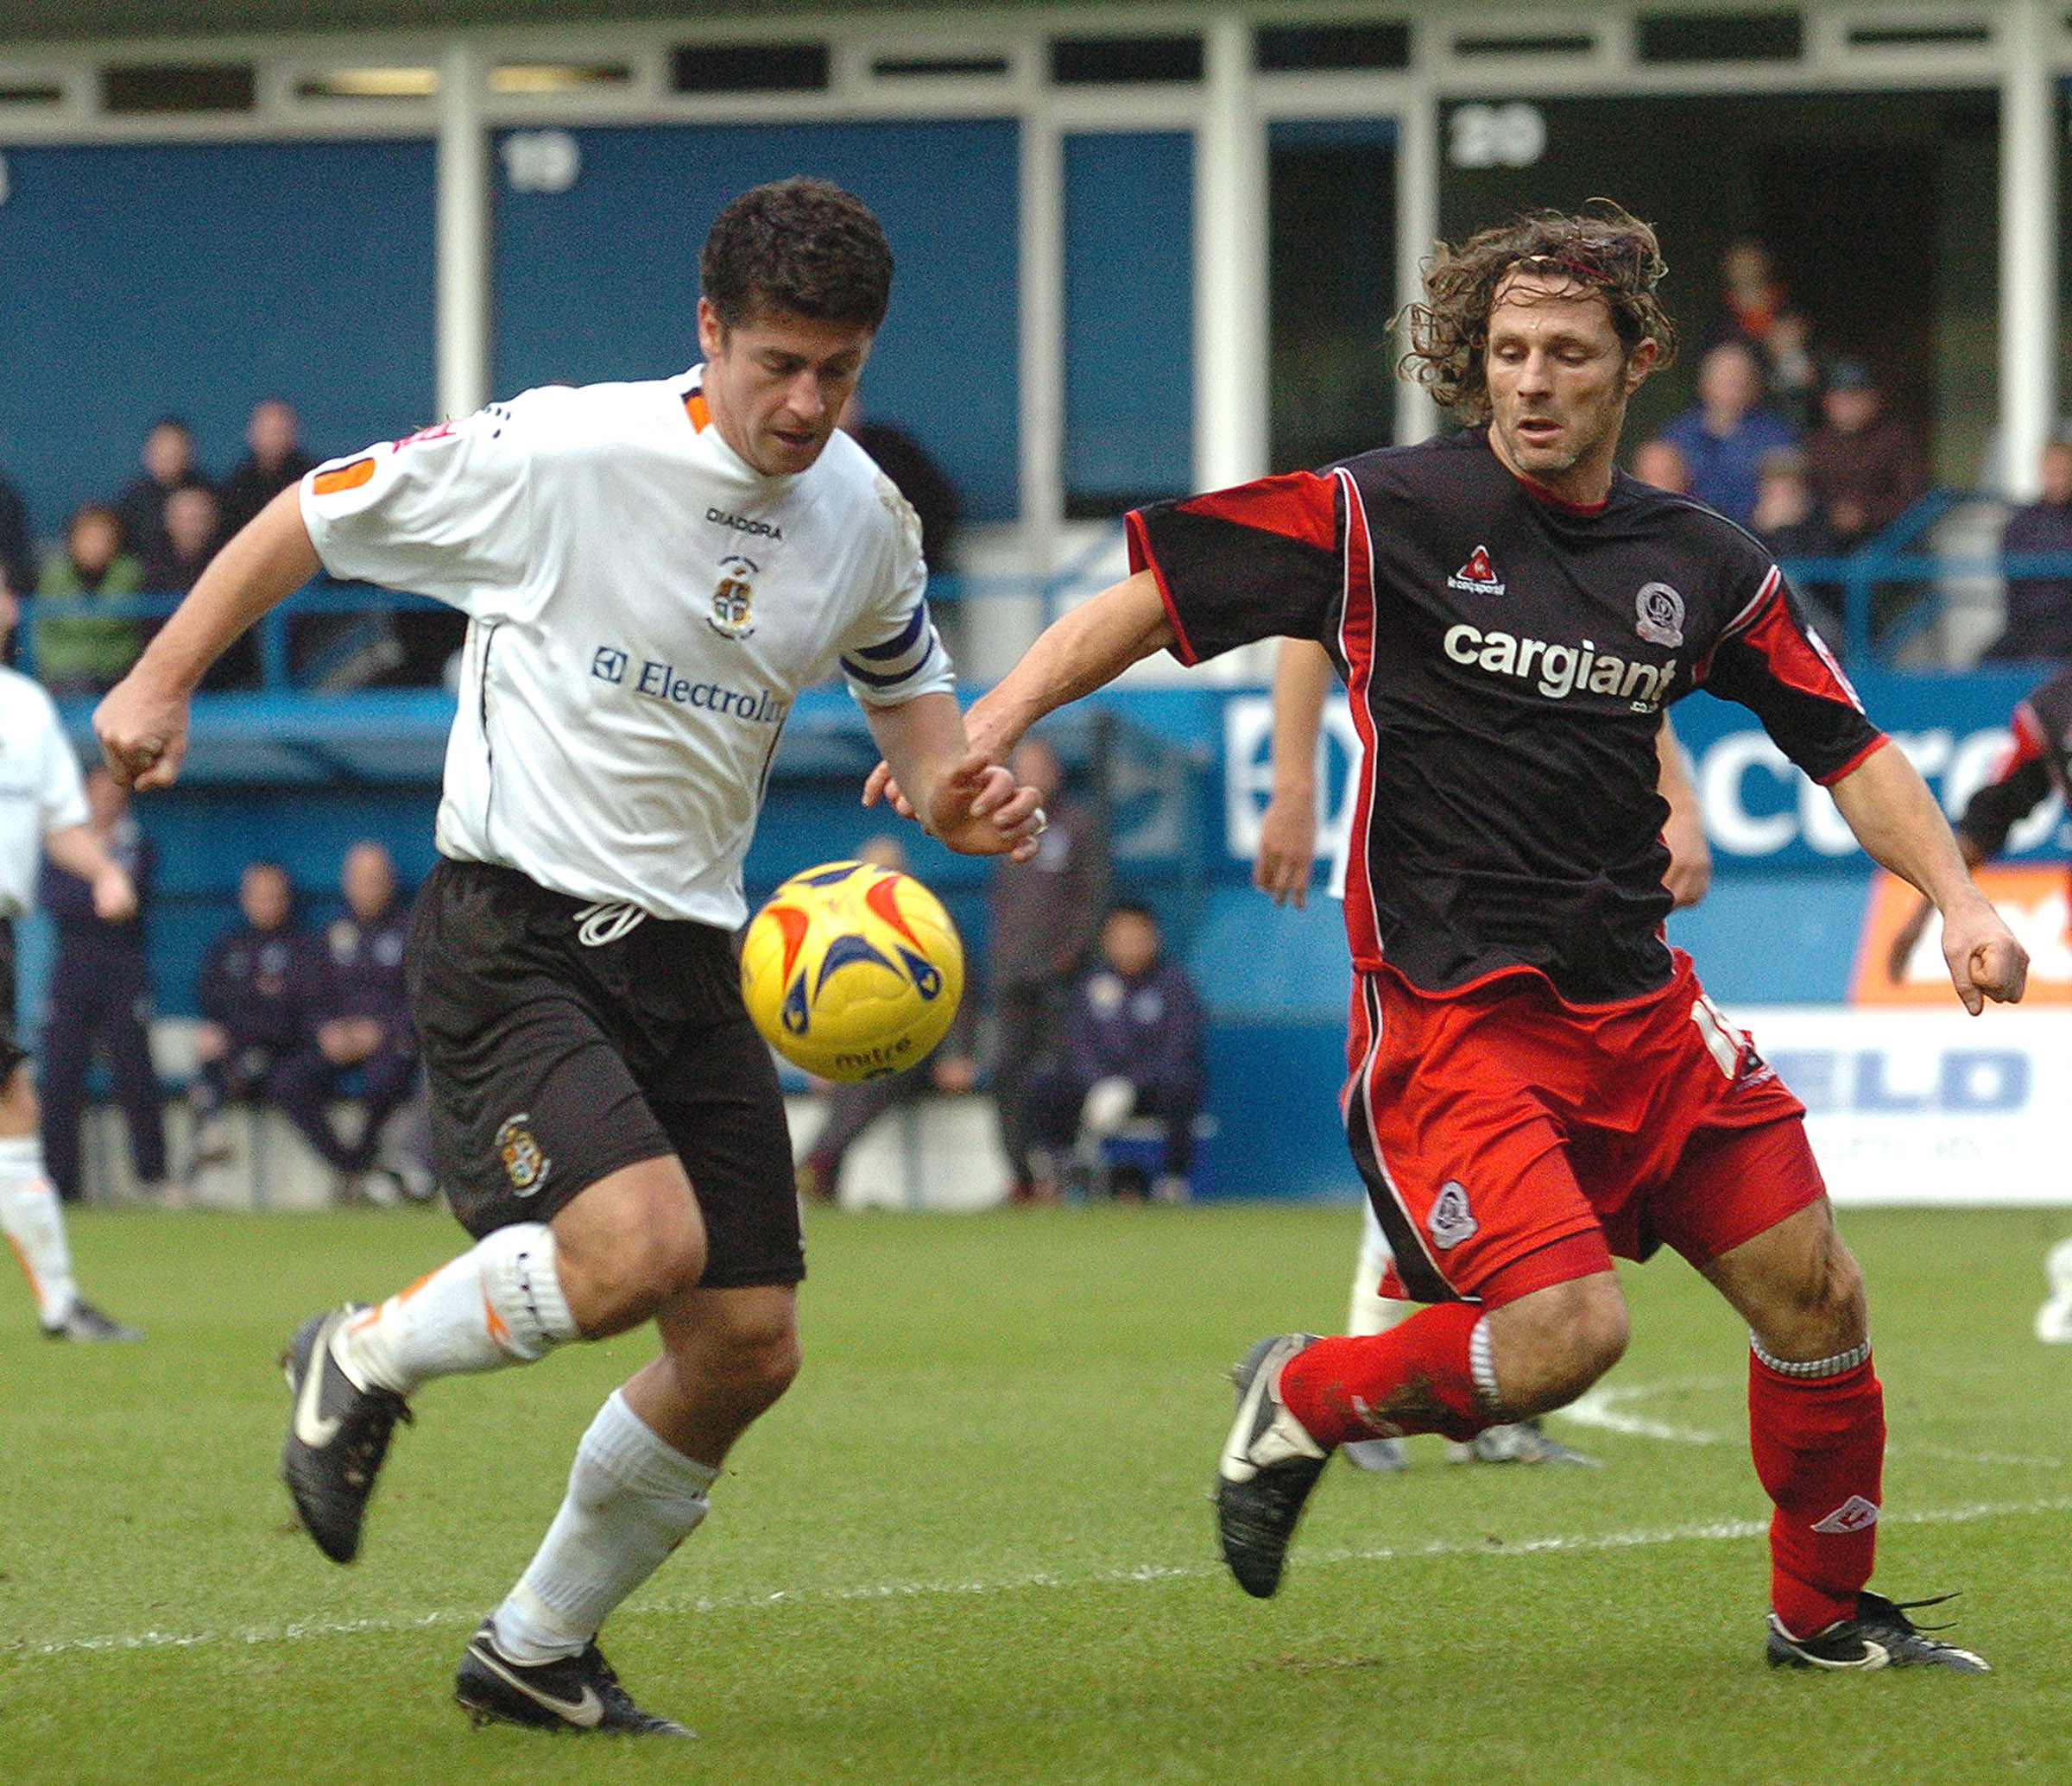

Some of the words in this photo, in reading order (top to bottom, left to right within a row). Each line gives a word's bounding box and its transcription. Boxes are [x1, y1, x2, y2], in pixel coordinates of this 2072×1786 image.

[706, 507, 783, 540] DIADORA
[1443, 623, 1677, 700] cargiant
[834, 1034, 912, 1068] mitre
